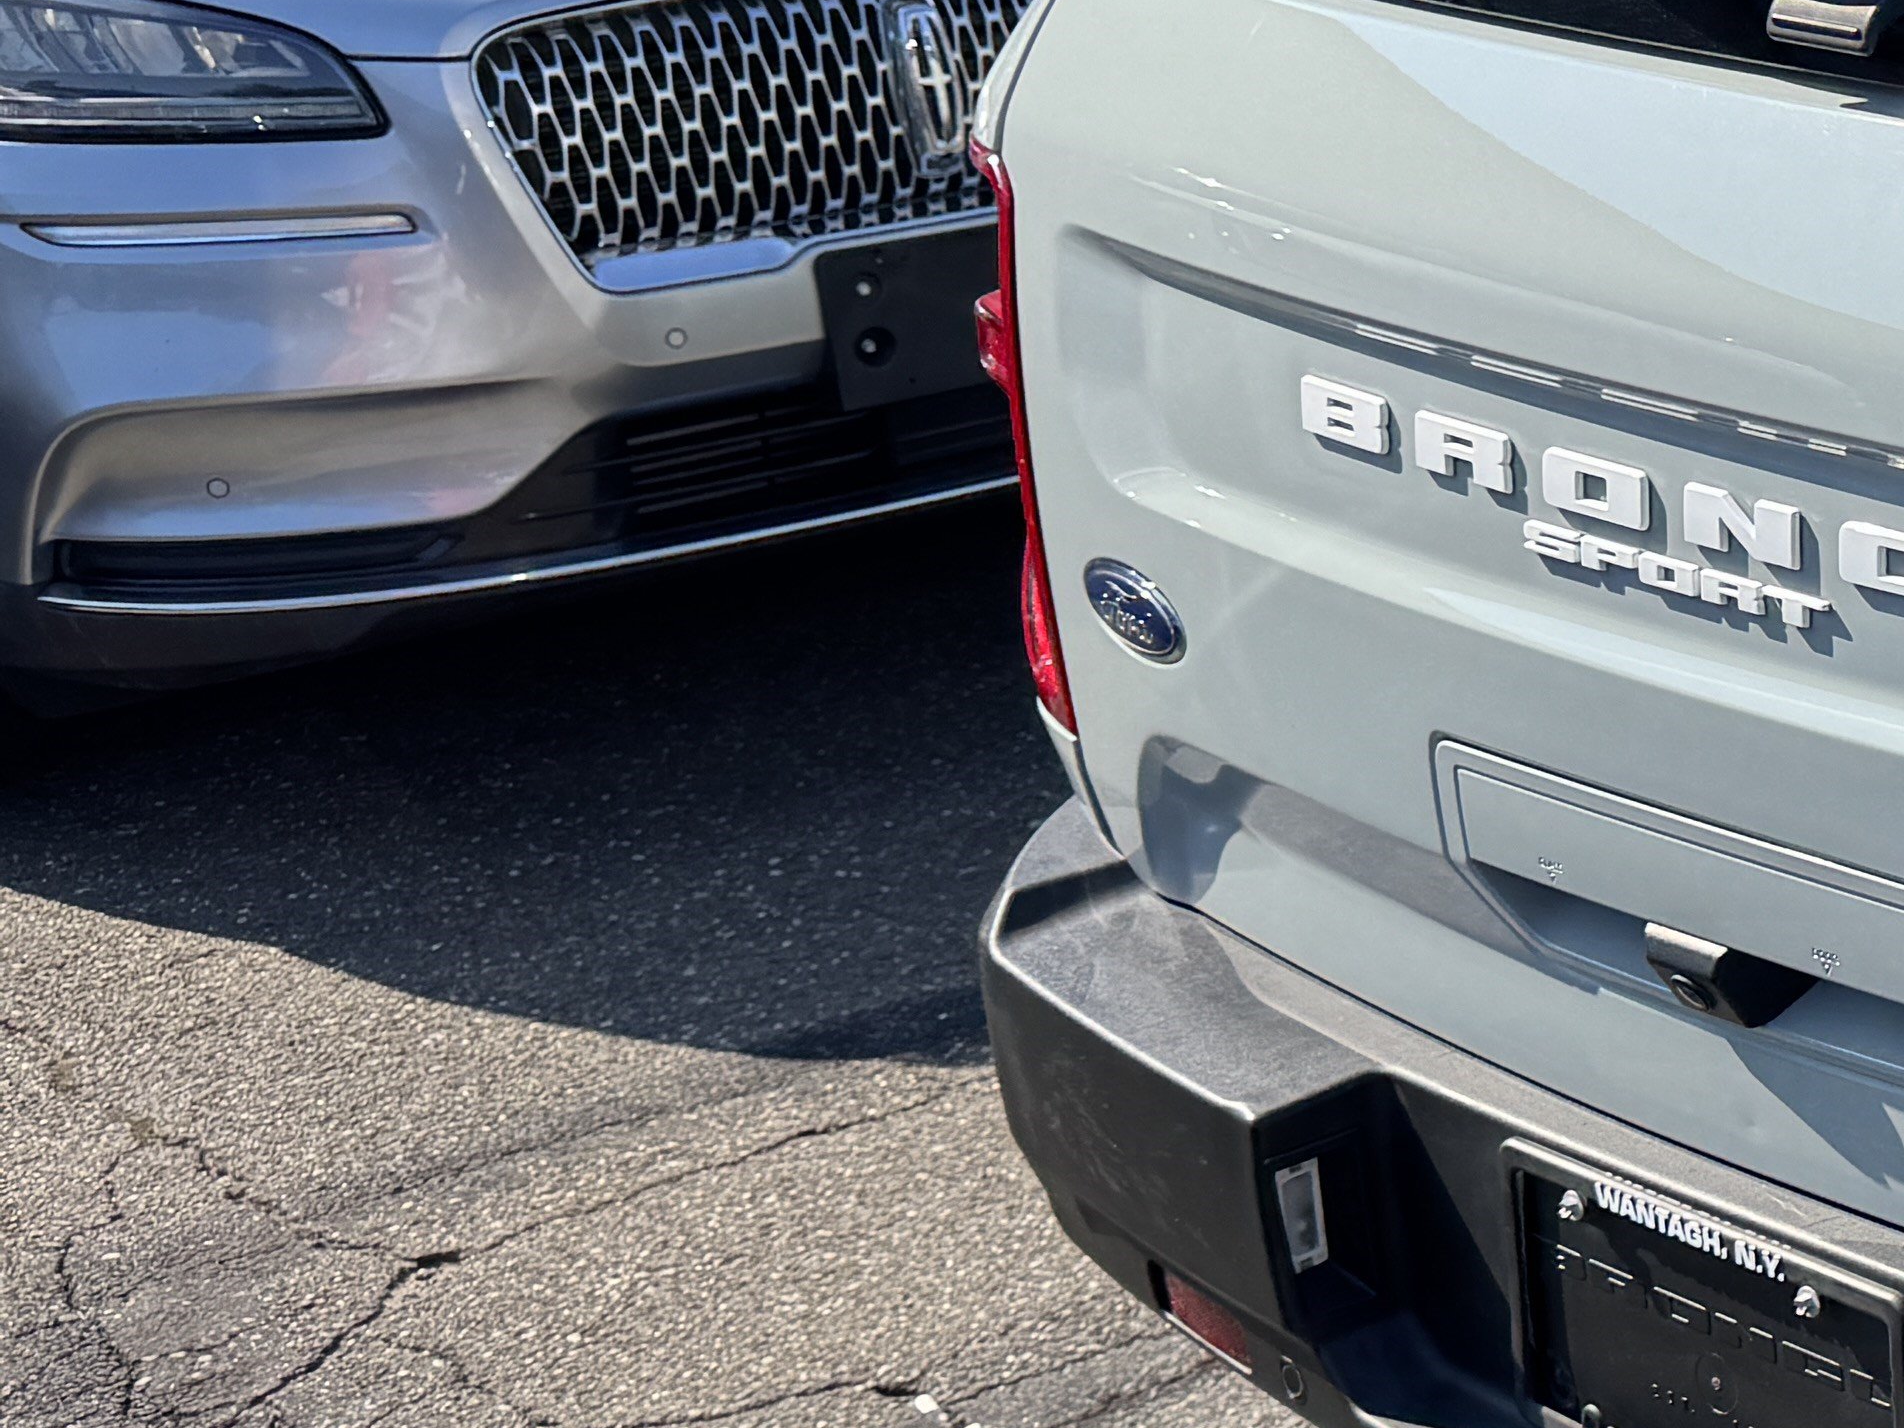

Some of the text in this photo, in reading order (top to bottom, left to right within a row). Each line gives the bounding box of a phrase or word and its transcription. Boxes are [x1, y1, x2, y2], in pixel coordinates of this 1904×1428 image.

[1523, 518, 1832, 629] SPORT
[1594, 1181, 1786, 1283] WANTAGH, N.Y.
